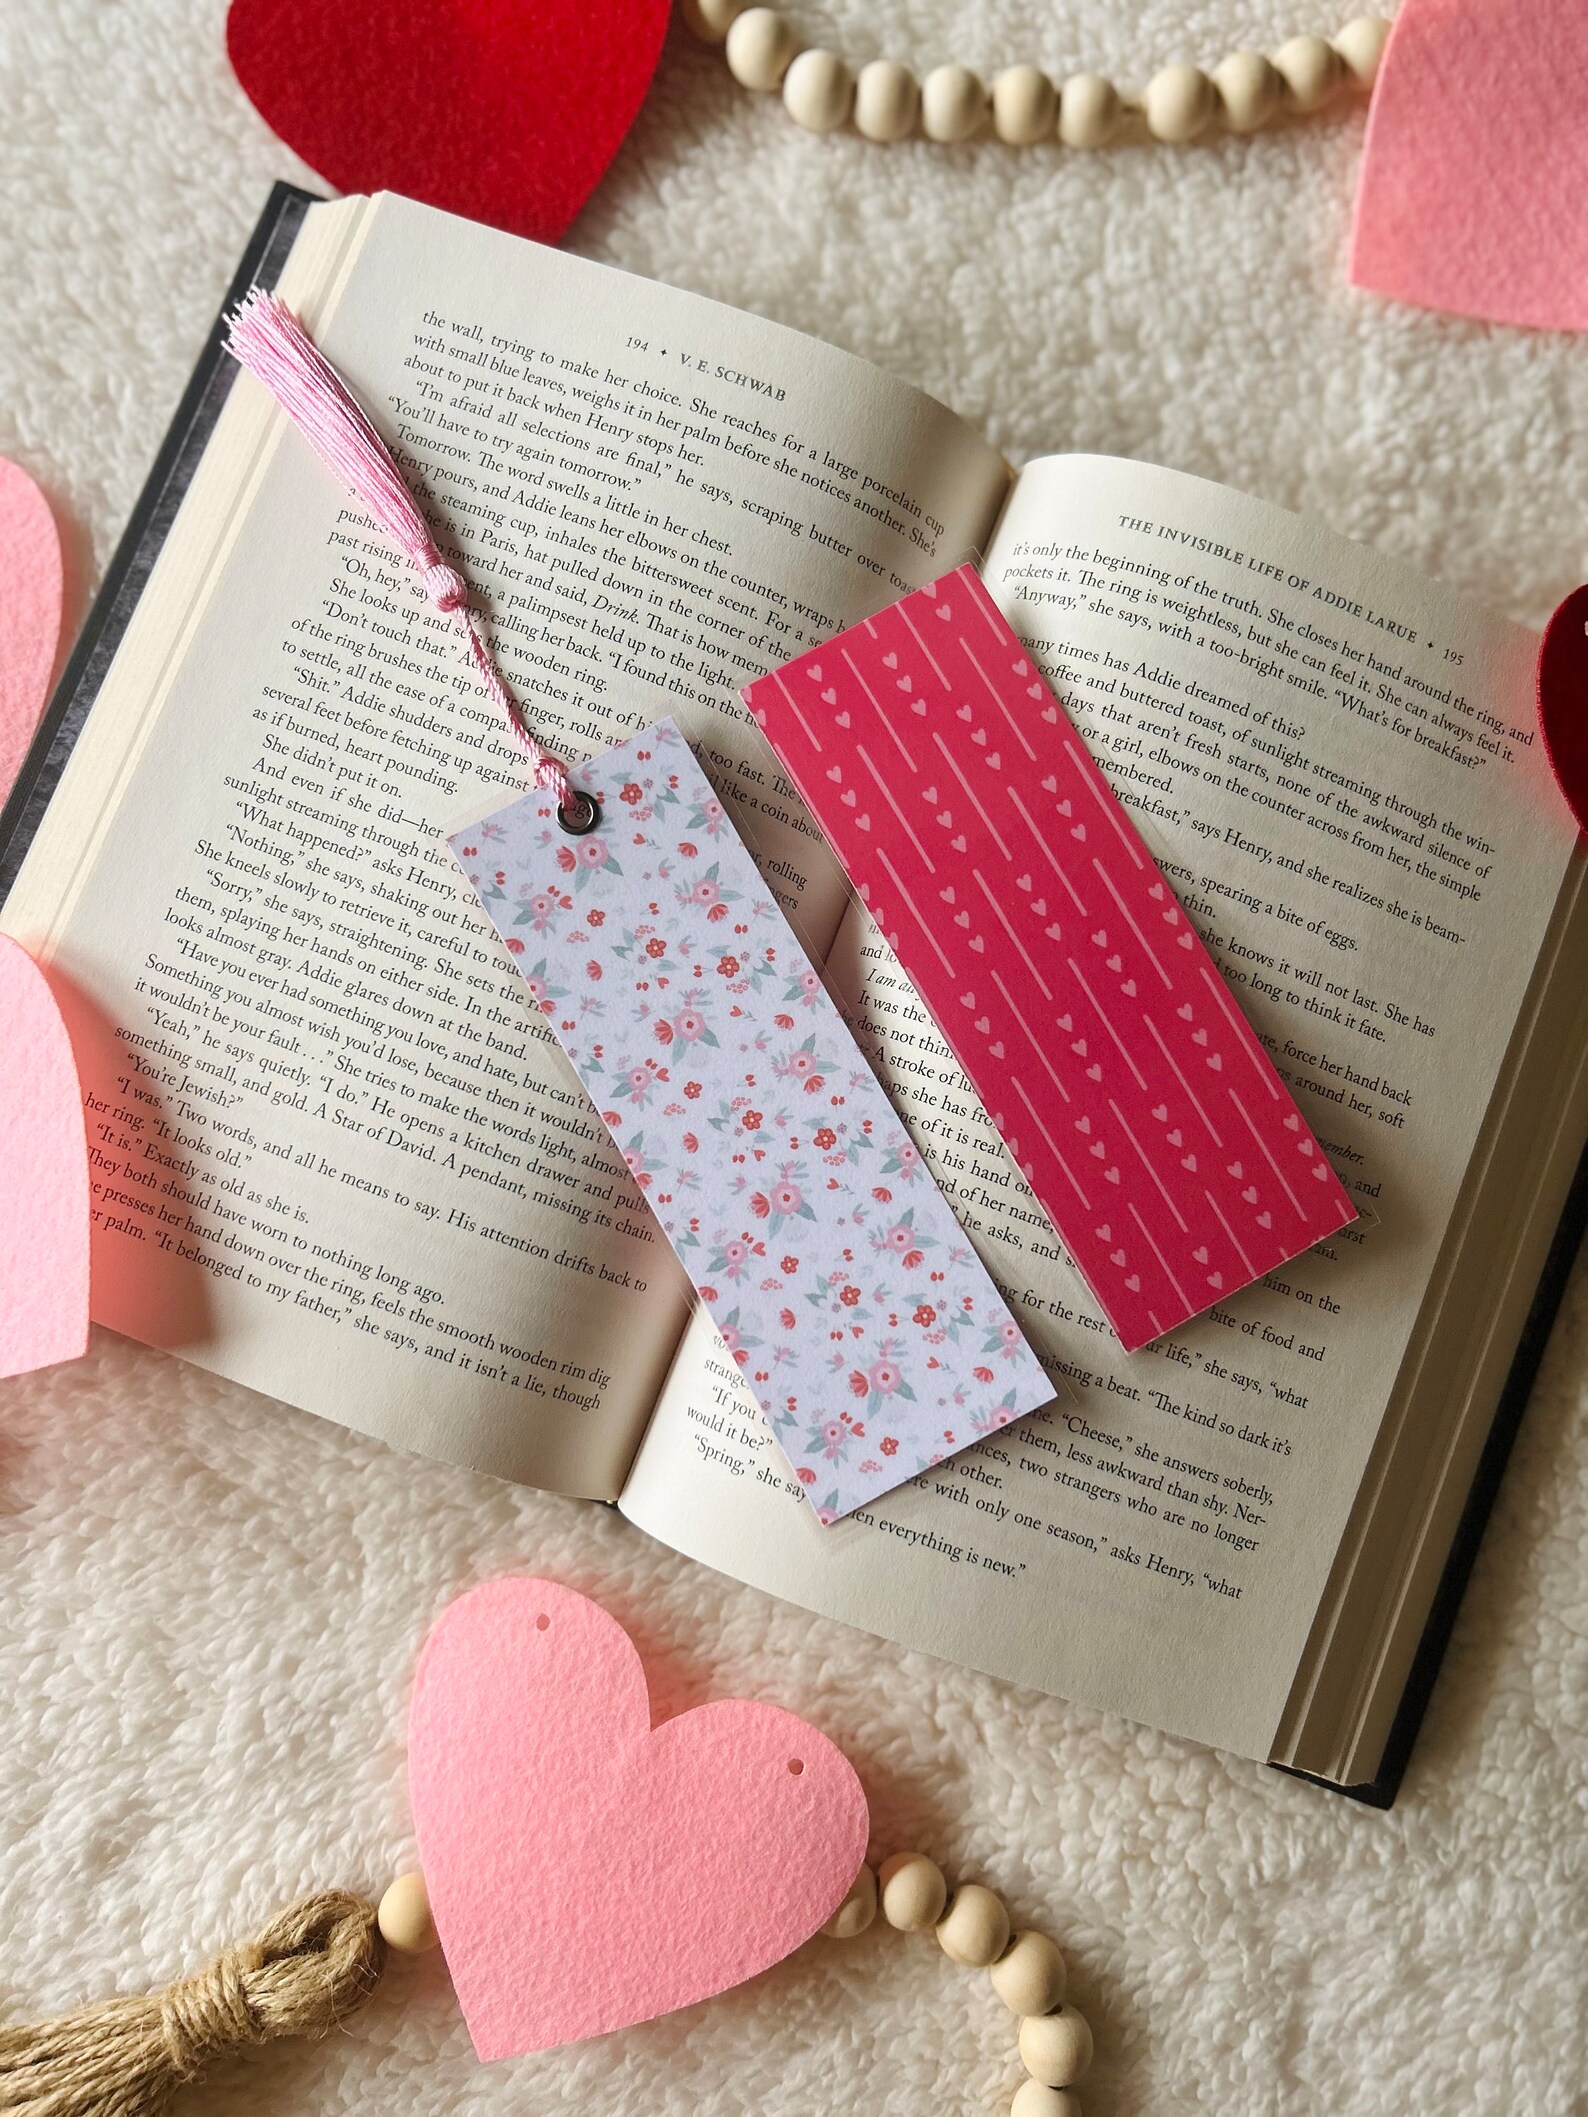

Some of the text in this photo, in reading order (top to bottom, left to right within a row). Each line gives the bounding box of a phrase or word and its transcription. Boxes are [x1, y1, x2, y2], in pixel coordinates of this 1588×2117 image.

[403, 354, 704, 466] about to put it back when Henry stops her.
[626, 336, 786, 402] 194 V. E. SCHWAB
[422, 310, 945, 539] the wall, trying to make her choice. She reaches for a large porcelain cup
[396, 423, 733, 557] Tomorrow. The word swells a little in her chest.
[1119, 515, 1465, 666] THE INVISIBLE LIFE OF ADDIE LARUE 195
[1032, 542, 1063, 561] only
[1065, 545, 1090, 561] the
[1092, 548, 1172, 587] beginning
[1174, 575, 1195, 590] of
[1193, 580, 1219, 600] the
[1221, 592, 1262, 619] truth.
[1266, 607, 1295, 632] She
[1297, 623, 1339, 651] closes
[1340, 640, 1366, 663] her
[1365, 652, 1404, 681] hand
[1403, 675, 1453, 705] around
[1453, 696, 1475, 717] the
[1475, 709, 1506, 736] ring,
[1508, 727, 1535, 747] and
[285, 715, 458, 796] burned, heart pounding.
[1038, 663, 1496, 855] coffee and buttered toast, of sunlight streaming through the win-
[223, 776, 448, 868] sunlight streaming through the
[1199, 876, 1358, 952] spearing a bite of eggs.
[163, 906, 527, 1061] looks almost gray. Addie glares down at the band.
[856, 989, 927, 1023] It was the
[1200, 927, 1436, 1037] she knows it will not last. She has
[872, 1046, 887, 1064] A
[888, 1055, 936, 1079] stroke
[938, 1071, 960, 1086] of
[114, 1027, 655, 1243] something small, and gold. A Star of David. A pendant, missing its chain.
[920, 1118, 1012, 1159] of it is real.
[122, 1162, 445, 1305] both should have worn to nothing long ago.
[1020, 1289, 1107, 1333] for the rest
[1209, 1304, 1326, 1362] bite of food and
[687, 1406, 725, 1433] would
[725, 1422, 738, 1440] it
[879, 1519, 964, 1563] everything
[965, 1547, 980, 1564] is
[935, 1482, 970, 1505] with
[975, 1499, 1010, 1523] only
[1014, 1512, 1042, 1531] one
[1109, 1545, 1142, 1565] asks
[1144, 1552, 1195, 1587] Henry,
[1019, 1457, 1260, 1552] two strangers who are no longer
